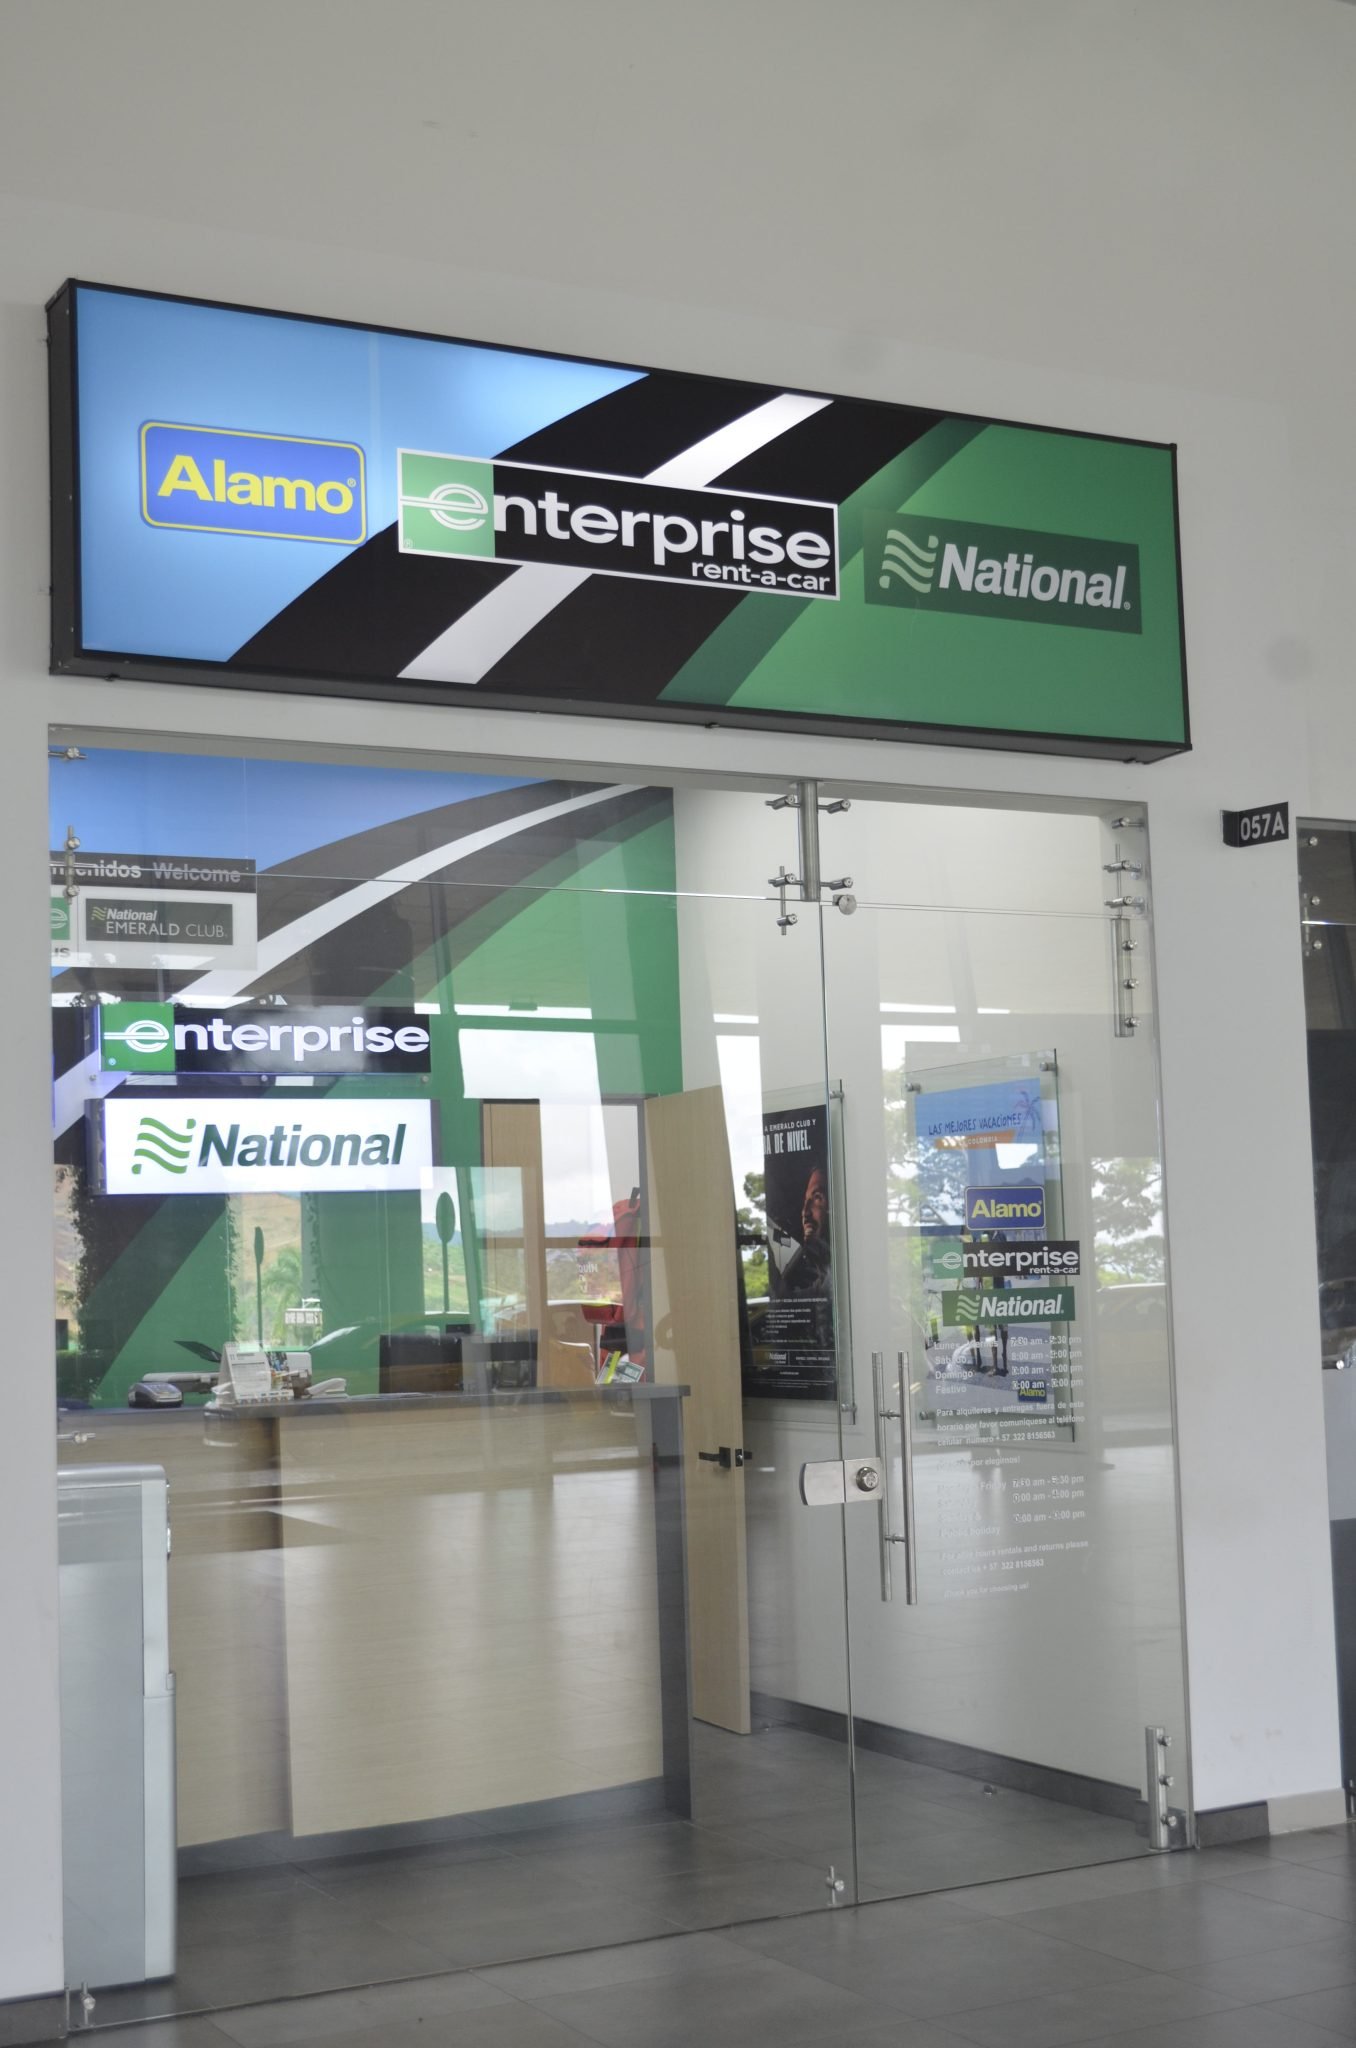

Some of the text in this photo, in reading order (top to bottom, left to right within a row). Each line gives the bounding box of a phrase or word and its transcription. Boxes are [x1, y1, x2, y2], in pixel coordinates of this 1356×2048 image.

[157, 455, 354, 515] Alamo
[429, 484, 831, 569] enterprise
[692, 559, 831, 592] rent-a-car
[939, 543, 1126, 610] National
[1240, 811, 1286, 841] 057A
[153, 862, 241, 882] Welcome
[106, 908, 157, 921] National
[106, 921, 225, 937] EMERALD CLUB
[123, 1017, 430, 1061] enterprise
[769, 1121, 795, 1131] EMERALD
[796, 1119, 811, 1128] CLUB
[928, 1122, 942, 1136] LAS
[198, 1123, 406, 1167] National
[774, 1132, 784, 1154] DE
[787, 1129, 811, 1152] NIVEL.
[972, 1199, 1041, 1218] Alamo
[942, 1246, 1079, 1272] enterprise
[1029, 1265, 1078, 1274] rent-a-car
[981, 1294, 1062, 1317] National
[1013, 1432, 1026, 1441] 322
